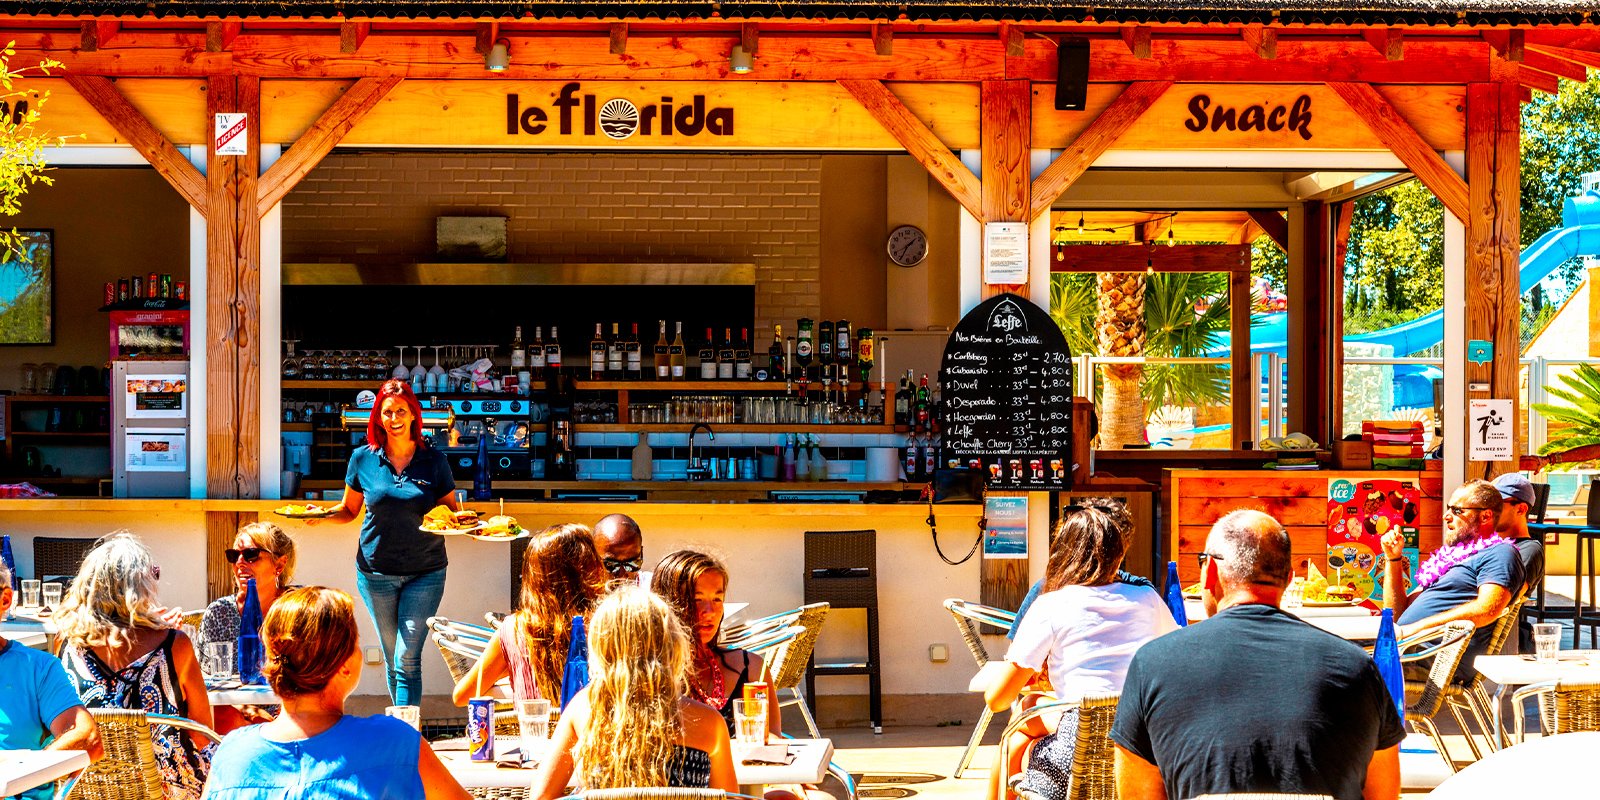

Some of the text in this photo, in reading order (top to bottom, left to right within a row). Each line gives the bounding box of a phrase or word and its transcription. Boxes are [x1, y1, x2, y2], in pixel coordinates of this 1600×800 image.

[1185, 94, 1313, 140] Snack
[217, 119, 246, 148] LICENCE
[992, 314, 1023, 332] Leffe
[955, 331, 969, 342] Nos
[953, 351, 988, 365] Carlsberg
[951, 365, 989, 374] Cubanisto
[953, 378, 979, 391] Duvel
[954, 424, 973, 439] Leffe
[1333, 487, 1349, 498] ice
